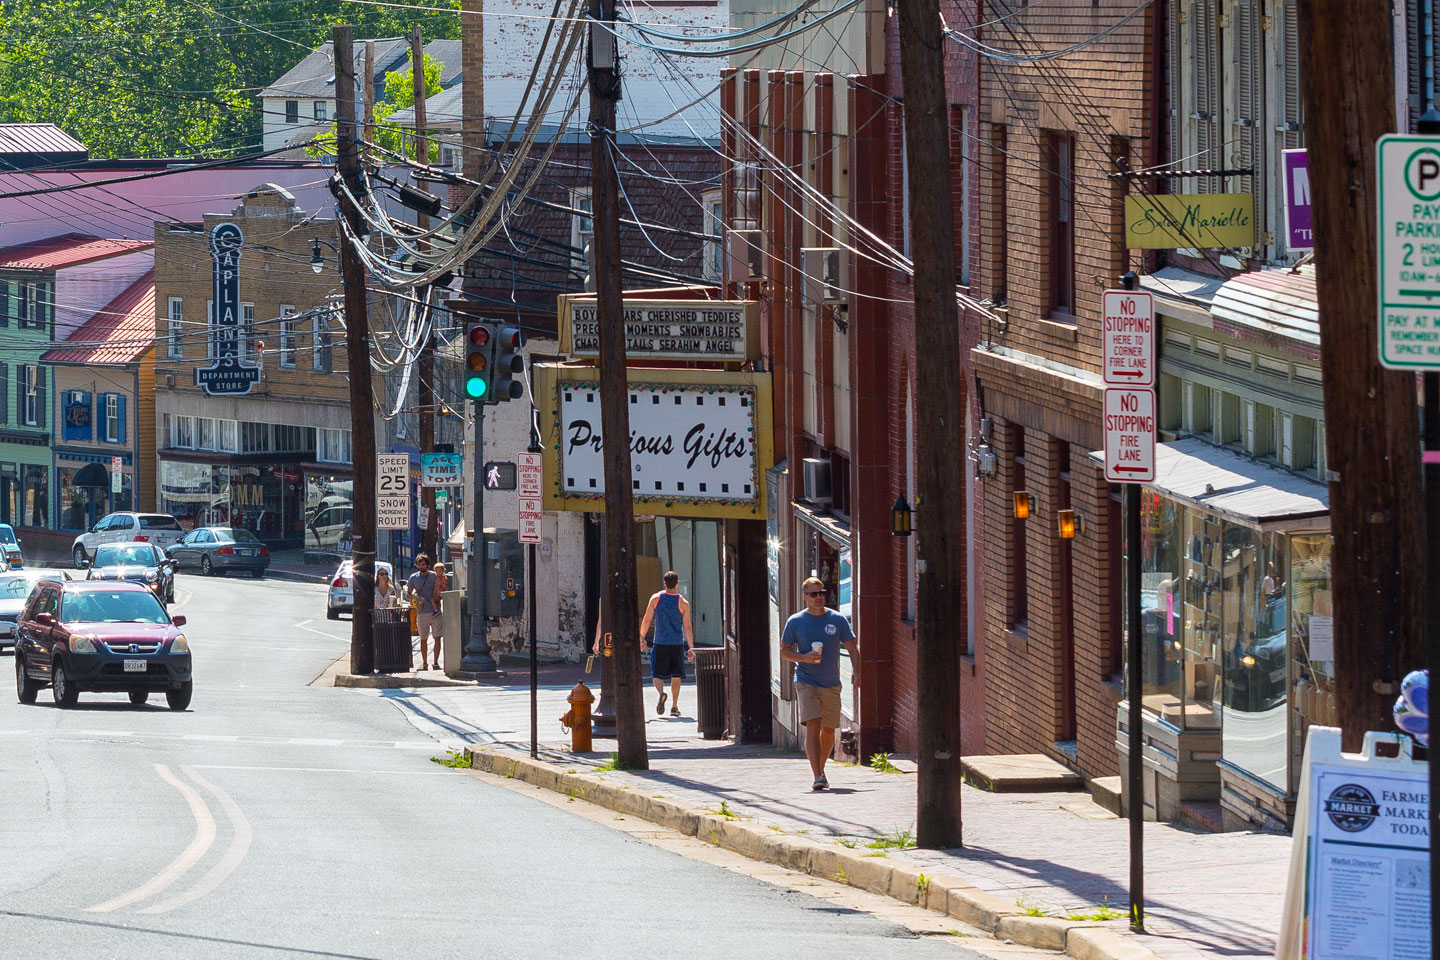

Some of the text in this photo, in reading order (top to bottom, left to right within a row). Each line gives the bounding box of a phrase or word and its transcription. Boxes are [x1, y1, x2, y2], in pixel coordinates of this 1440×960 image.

[1418, 159, 1440, 191] P
[1413, 204, 1440, 219] PAY
[1178, 204, 1249, 238] Marielle
[1396, 221, 1440, 238] PARKI
[1402, 243, 1440, 266] 2 HO
[220, 230, 235, 368] CAPLAN'S
[1120, 300, 1136, 316] NO
[625, 311, 642, 322] ARS
[647, 311, 697, 322] CHERISHED
[702, 312, 740, 323] TEDDIES
[1387, 314, 1408, 327] PAY
[1414, 316, 1428, 327] AT
[576, 323, 741, 338] PREC MOMENTS SNOWBABIES
[1106, 316, 1150, 333] STOPPING
[1112, 335, 1144, 345] HERE TO
[1390, 330, 1439, 341] REMEMBER
[575, 338, 735, 352] CHAR TAILS SERAHIM ANGEL
[1114, 346, 1143, 357] CORNER
[1394, 344, 1423, 354] SPACE
[1109, 357, 1147, 369] FIRE LANE
[202, 371, 256, 380] DEPARTMENT
[216, 382, 242, 390] STORE
[1120, 395, 1139, 412] NO
[1106, 414, 1153, 433] STOPPING
[568, 419, 748, 470] Prious Gifts
[1120, 435, 1140, 448] FIRE
[431, 456, 454, 465] ALL
[525, 457, 534, 465] NO
[1118, 449, 1142, 462] LANE
[380, 475, 406, 491] 25
[427, 475, 458, 483] TOYS
[380, 499, 406, 507] SNOW
[525, 501, 535, 510] NO
[378, 517, 408, 525] ROUTE
[519, 511, 542, 520] STOPPING
[1382, 790, 1429, 803] FARME
[1331, 802, 1372, 814] MARKET
[1385, 807, 1430, 820] MARK
[1390, 823, 1429, 836] TODA
